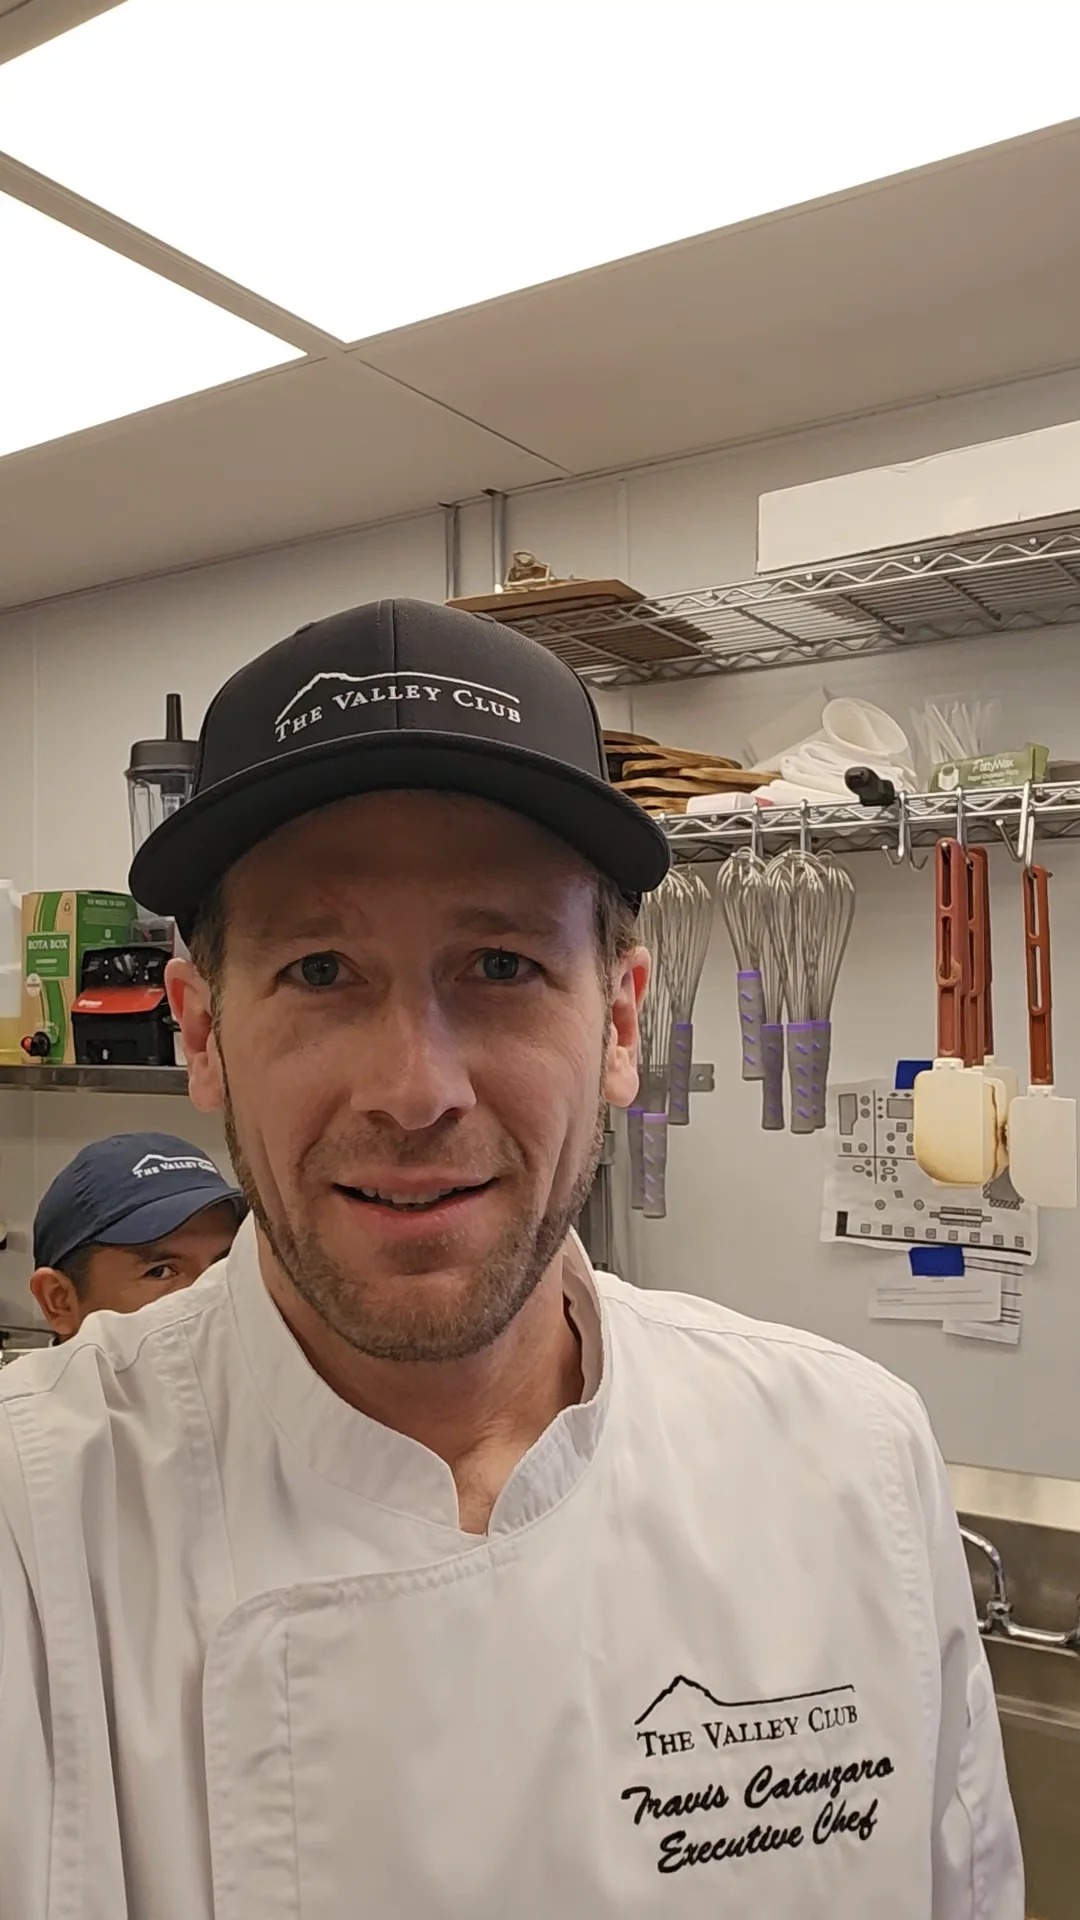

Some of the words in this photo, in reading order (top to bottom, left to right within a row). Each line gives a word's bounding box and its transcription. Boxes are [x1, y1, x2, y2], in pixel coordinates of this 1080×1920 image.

[274, 706, 323, 743] THE
[332, 685, 442, 711] VALLEY
[452, 689, 522, 724] CLUB
[28, 939, 49, 950] BOTA
[50, 939, 68, 950] BOX
[133, 1166, 160, 1178] THE
[160, 1162, 197, 1170] VALLEY
[636, 1730, 696, 1758] THE
[702, 1716, 800, 1749] VALLEY
[808, 1704, 858, 1733] CLUB
[620, 1784, 730, 1826] Travis
[743, 1756, 894, 1809] Catanzaro
[657, 1825, 804, 1874] Executive
[812, 1798, 878, 1845] Chef
